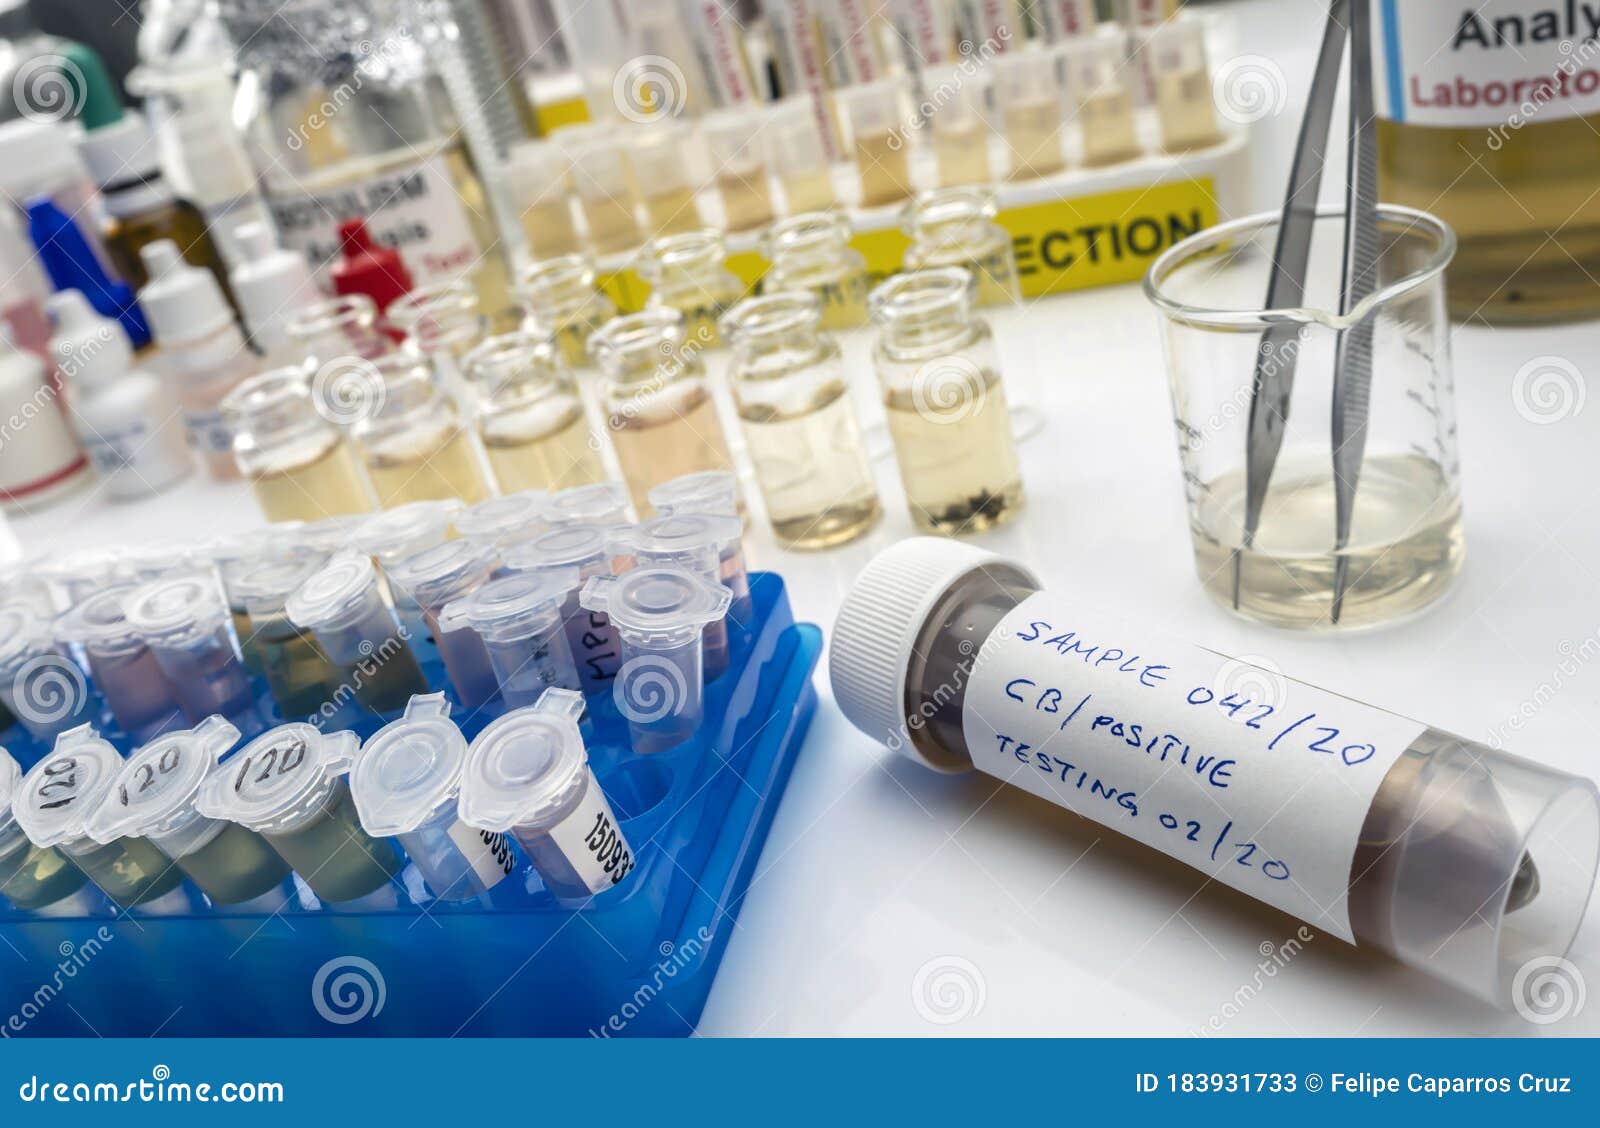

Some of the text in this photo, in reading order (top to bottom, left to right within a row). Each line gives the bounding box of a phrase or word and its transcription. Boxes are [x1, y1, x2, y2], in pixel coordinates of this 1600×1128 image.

[1012, 210, 1206, 276] ECTION
[1016, 621, 1375, 766] SAMPLE 042/20
[118, 746, 182, 807] 120
[996, 732, 1291, 881] TESTING 02/20
[584, 811, 635, 885] 15093
